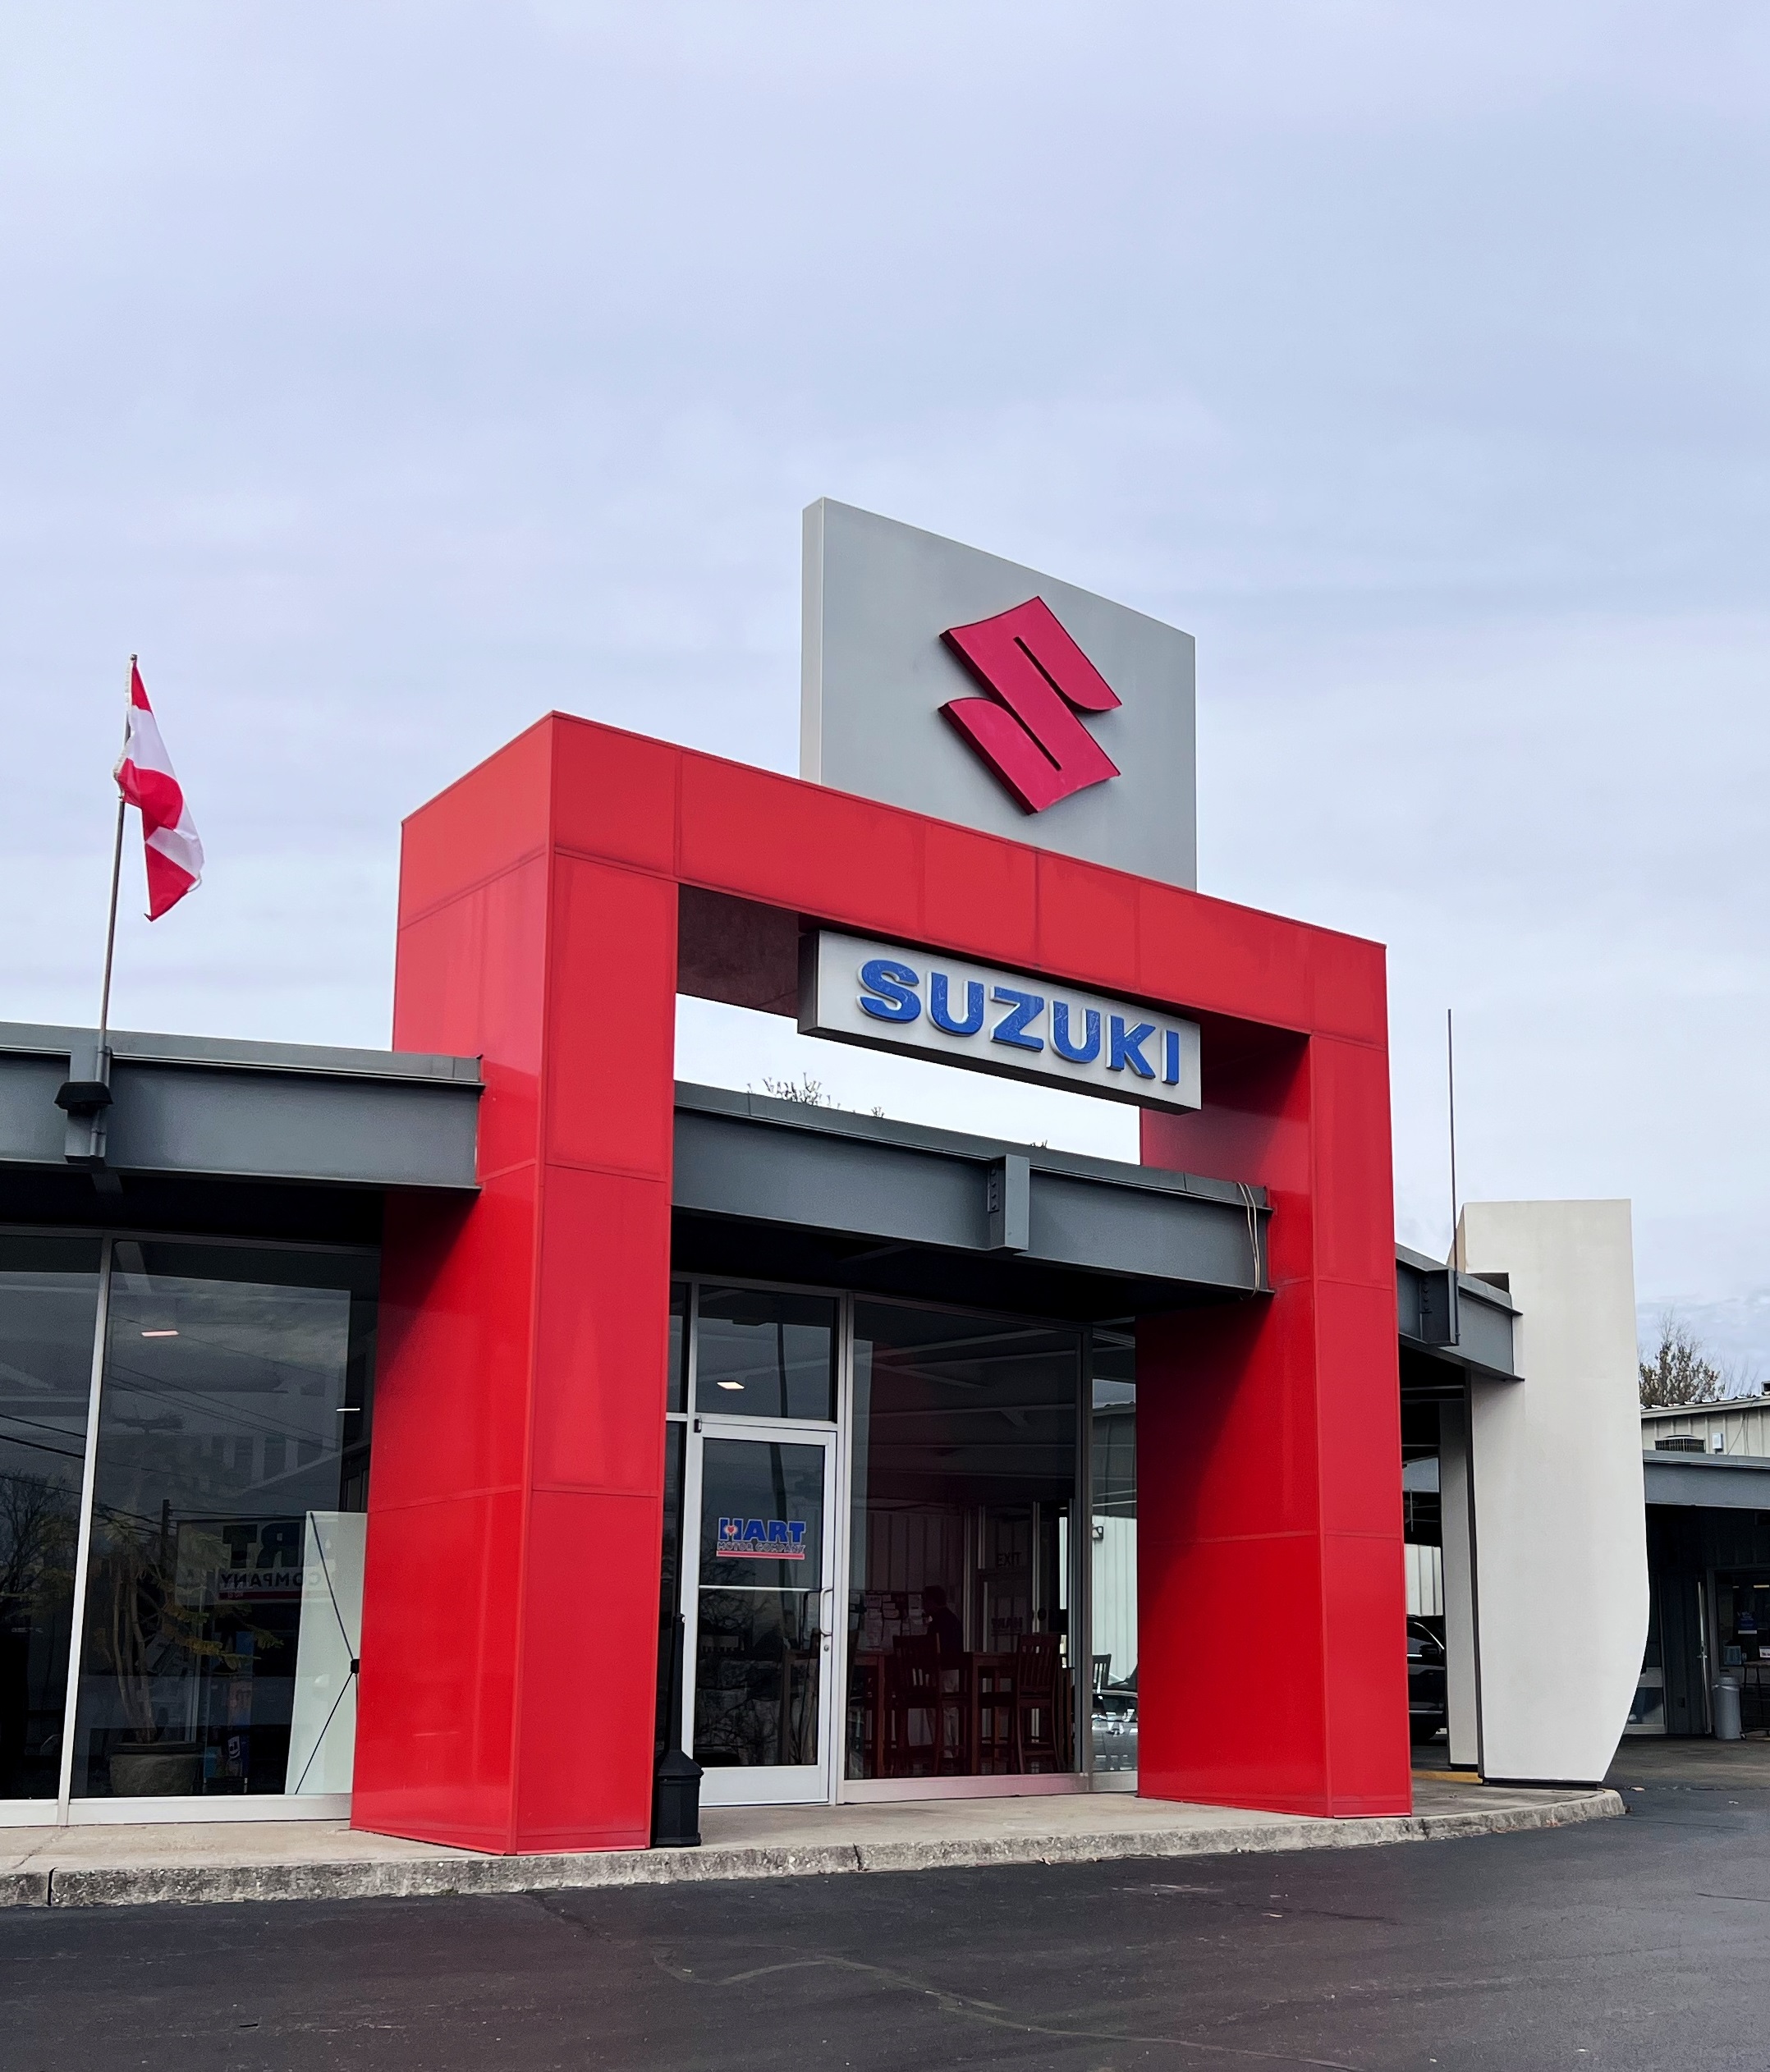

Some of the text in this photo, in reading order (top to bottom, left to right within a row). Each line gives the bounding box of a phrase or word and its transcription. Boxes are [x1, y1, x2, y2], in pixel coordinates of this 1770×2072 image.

[856, 960, 1180, 1086] SUZUKI
[718, 1517, 806, 1543] HART
[717, 1541, 806, 1554] MOTOR COMPANY
[997, 1552, 1022, 1567] EXIT
